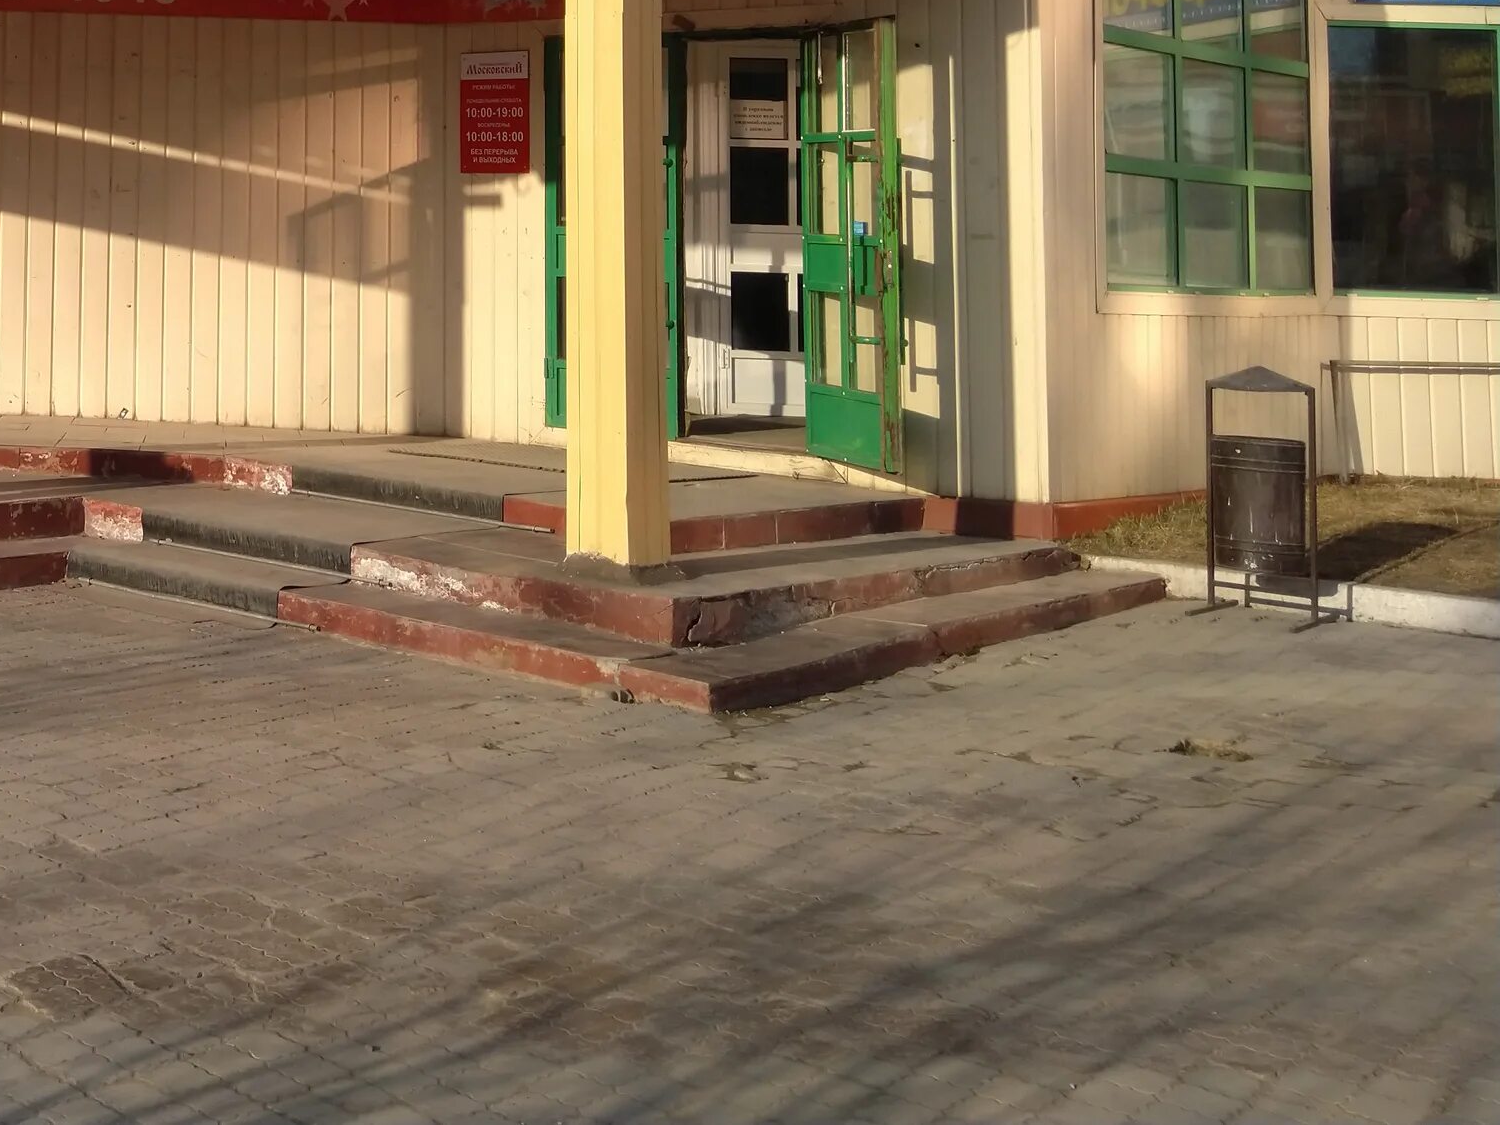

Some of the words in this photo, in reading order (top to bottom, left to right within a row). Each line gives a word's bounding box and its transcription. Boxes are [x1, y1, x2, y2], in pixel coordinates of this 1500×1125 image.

[466, 107, 524, 118] 10:00-19:00
[466, 131, 524, 142] 10:00-18:00
[470, 148, 483, 156] БЕЗ
[483, 148, 518, 156] ПЕРЕРЫВА
[472, 156, 478, 164] И
[478, 156, 516, 164] ВЫХОДНЫХ
